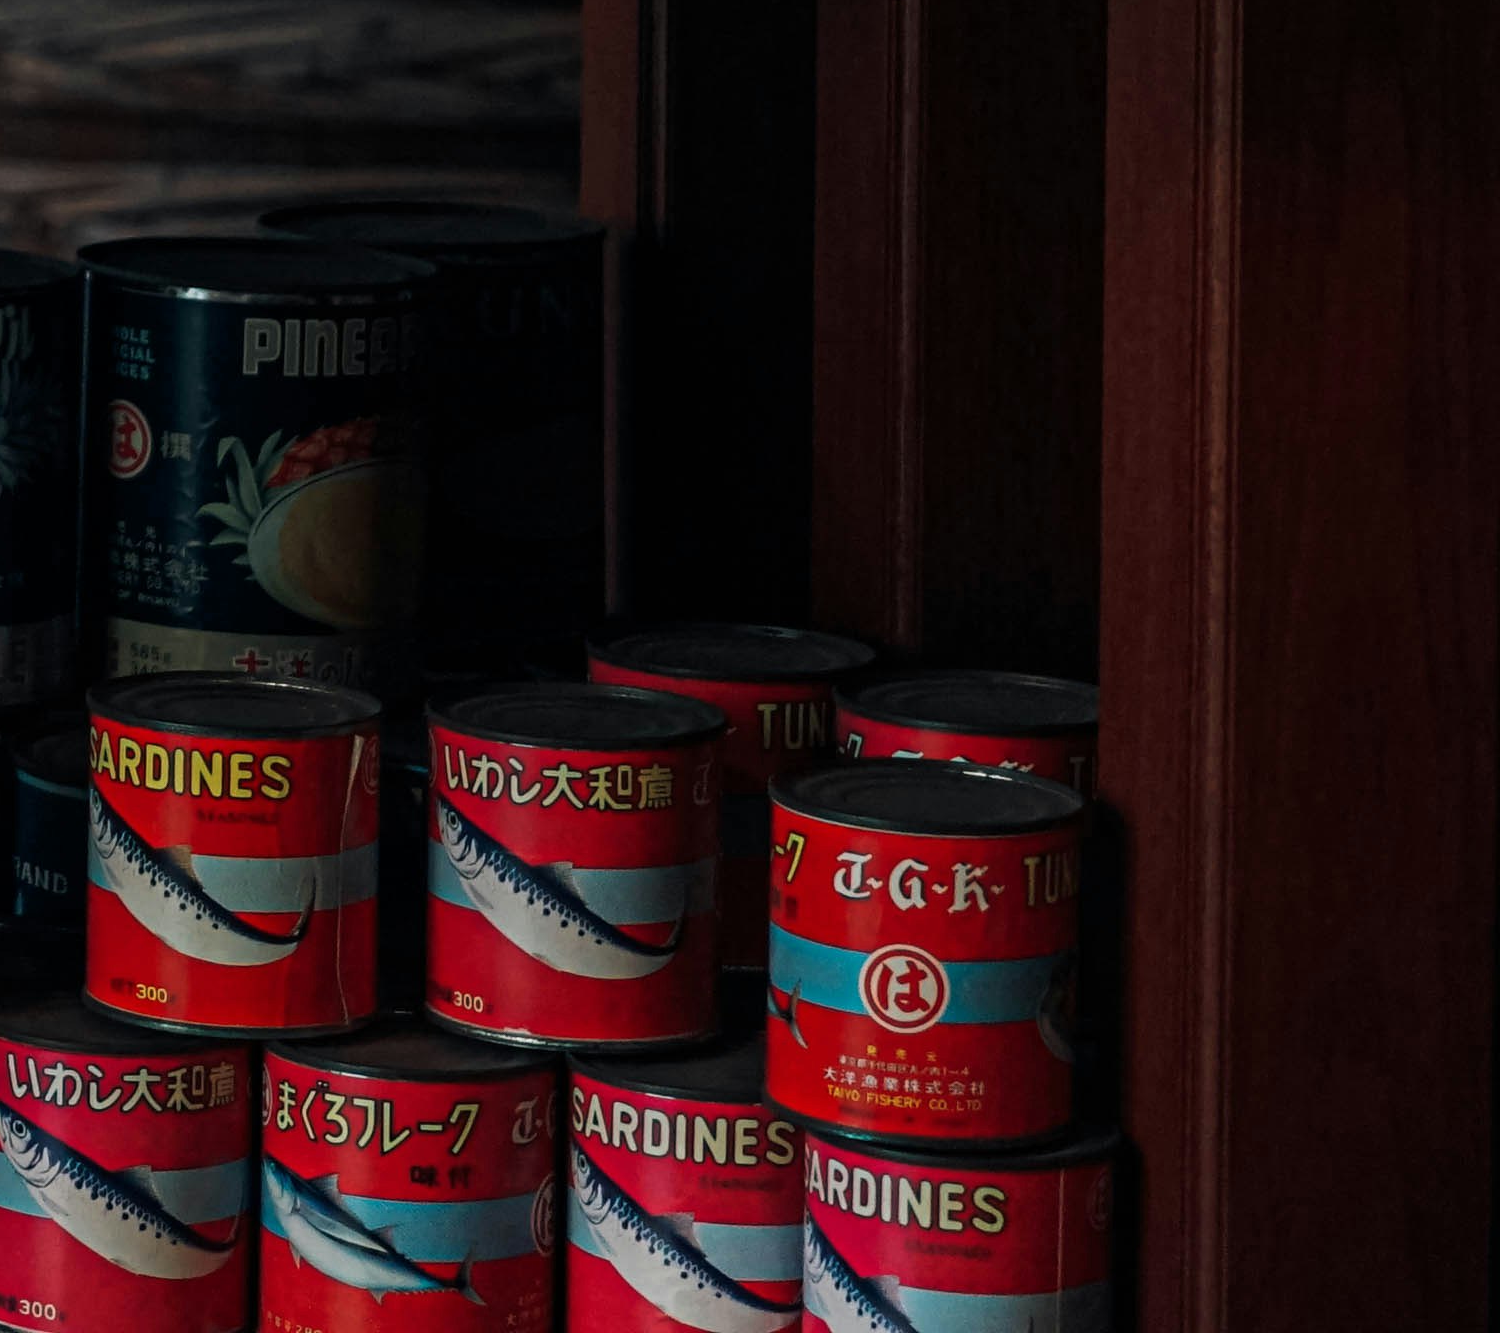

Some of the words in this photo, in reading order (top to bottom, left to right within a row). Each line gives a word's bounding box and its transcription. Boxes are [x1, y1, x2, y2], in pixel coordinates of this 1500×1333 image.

[88, 729, 291, 801] SARDINES
[444, 745, 675, 810] いわし大和煮
[135, 983, 168, 1005] 300
[452, 994, 485, 1014] 300
[7, 1051, 235, 1116] いわし大和煮
[827, 1084, 861, 1103] TAIYO
[866, 1093, 923, 1109] FISHERY
[572, 1085, 795, 1165] SARDINES
[802, 1142, 1008, 1234] SARDINES
[18, 1298, 56, 1323] 300
